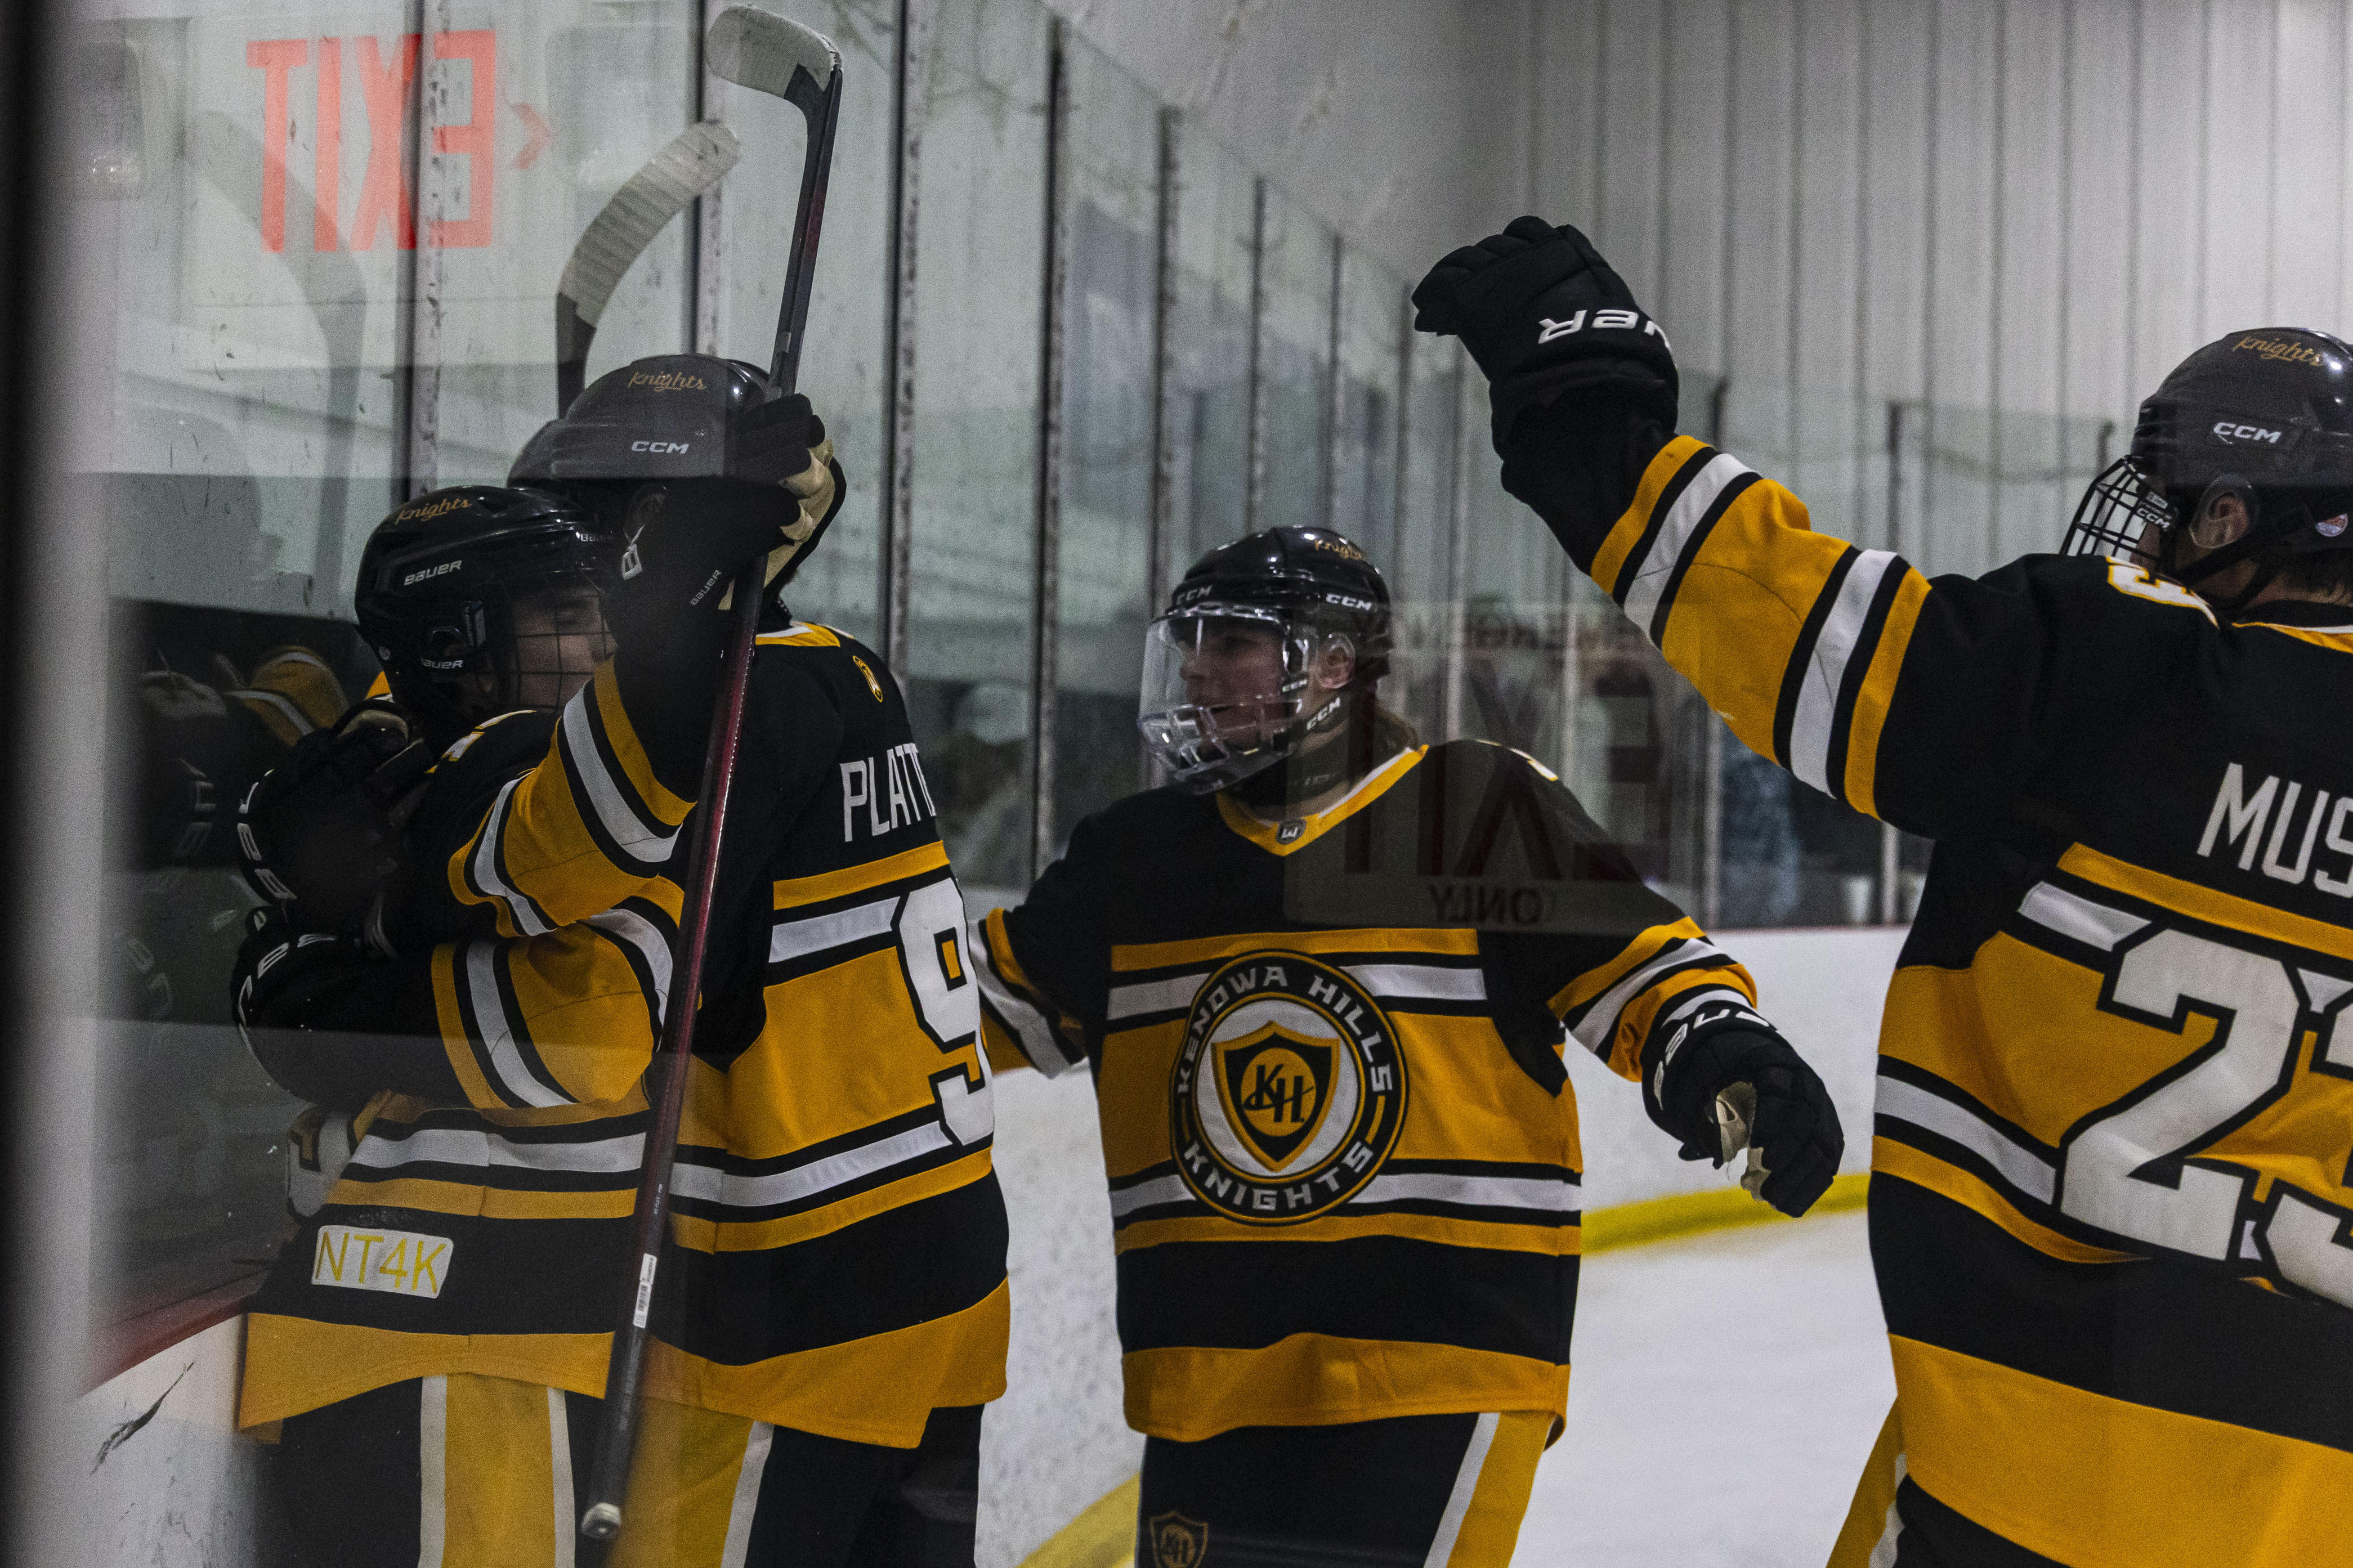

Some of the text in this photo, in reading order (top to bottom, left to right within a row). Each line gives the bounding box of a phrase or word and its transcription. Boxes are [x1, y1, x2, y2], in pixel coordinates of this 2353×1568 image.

[2232, 337, 2326, 367] Knights
[628, 370, 708, 393] Knights
[630, 440, 690, 455] CCM
[2213, 422, 2282, 444] CCM
[395, 498, 473, 526] Knights
[404, 559, 462, 586] BAUER
[690, 569, 722, 605] BAUER
[1325, 593, 1373, 611] CCM
[1306, 697, 1341, 731] CCM
[840, 742, 937, 842] PLATT
[1178, 966, 1393, 1094] KENOWA HILLS
[1254, 1064, 1304, 1123] KH
[1184, 1141, 1374, 1211] KNIGHTS
[315, 1231, 447, 1294] NT4K
